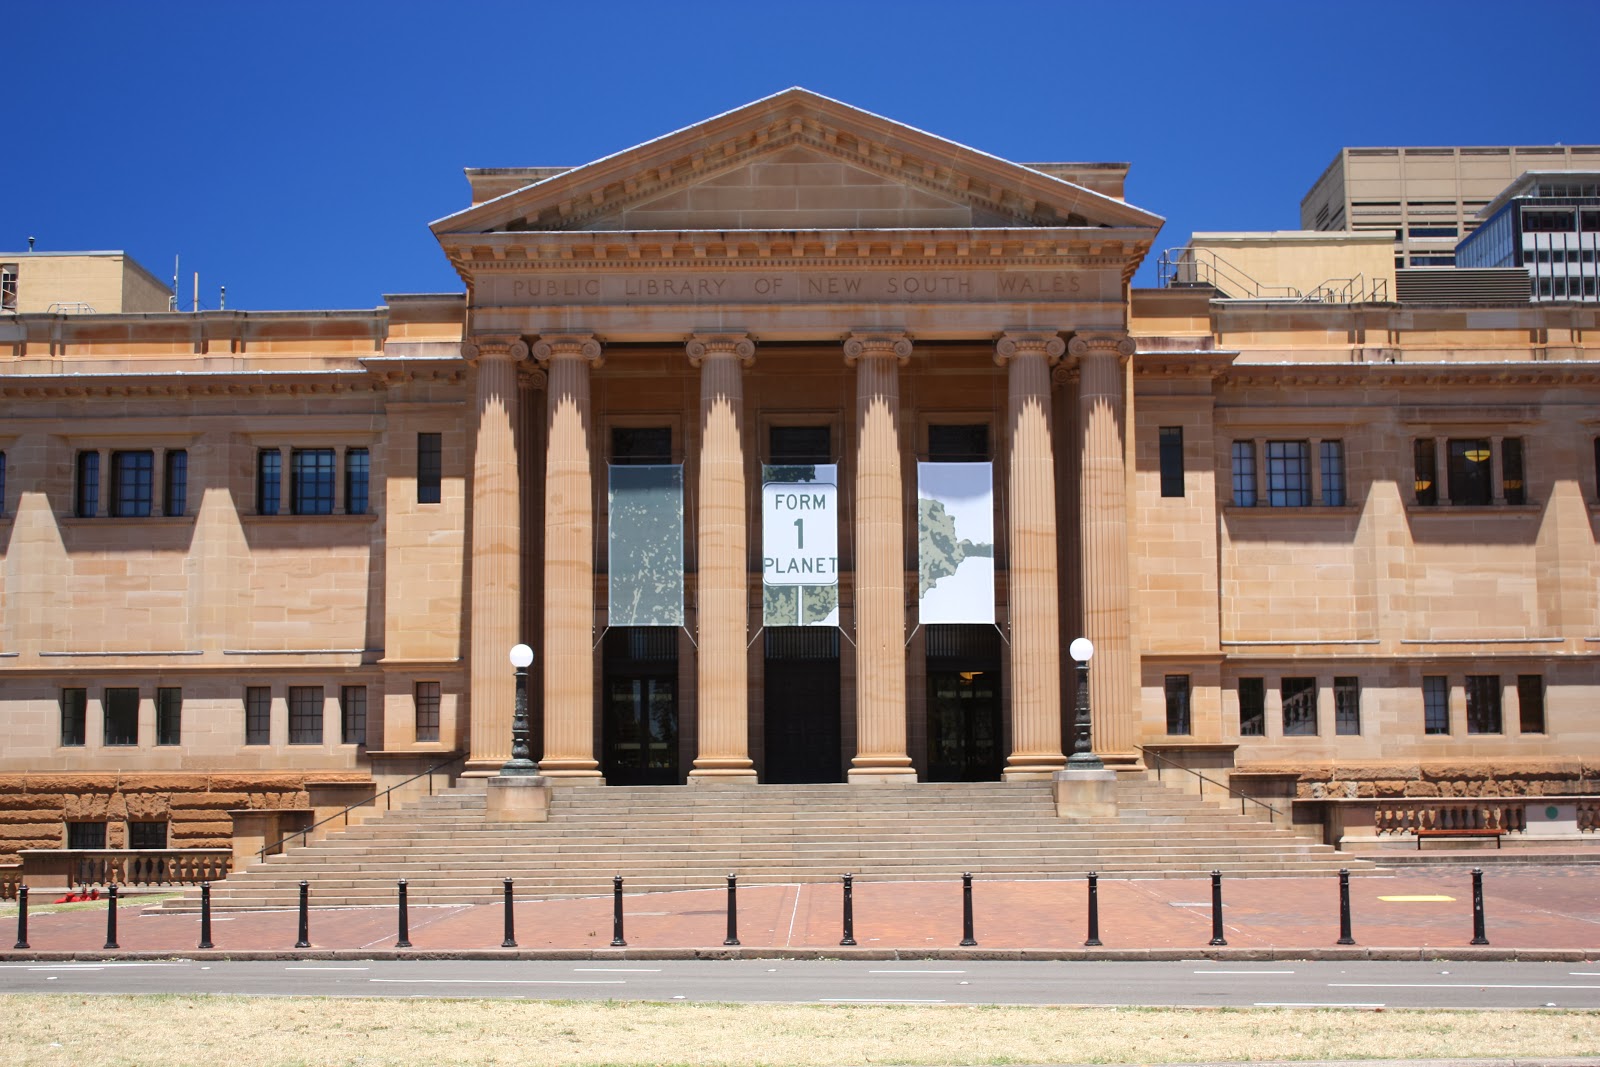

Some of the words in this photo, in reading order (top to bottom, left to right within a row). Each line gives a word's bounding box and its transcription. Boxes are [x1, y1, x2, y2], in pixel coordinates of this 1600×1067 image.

[513, 279, 599, 296] PUBLIC
[625, 278, 726, 296] LIBRARY
[754, 278, 783, 294] OF
[808, 277, 862, 294] NEW
[886, 276, 972, 293] SOUTH
[1000, 276, 1081, 293] WALES
[775, 494, 826, 510] FORM
[793, 518, 804, 549] 1
[763, 557, 838, 574] PLANET
